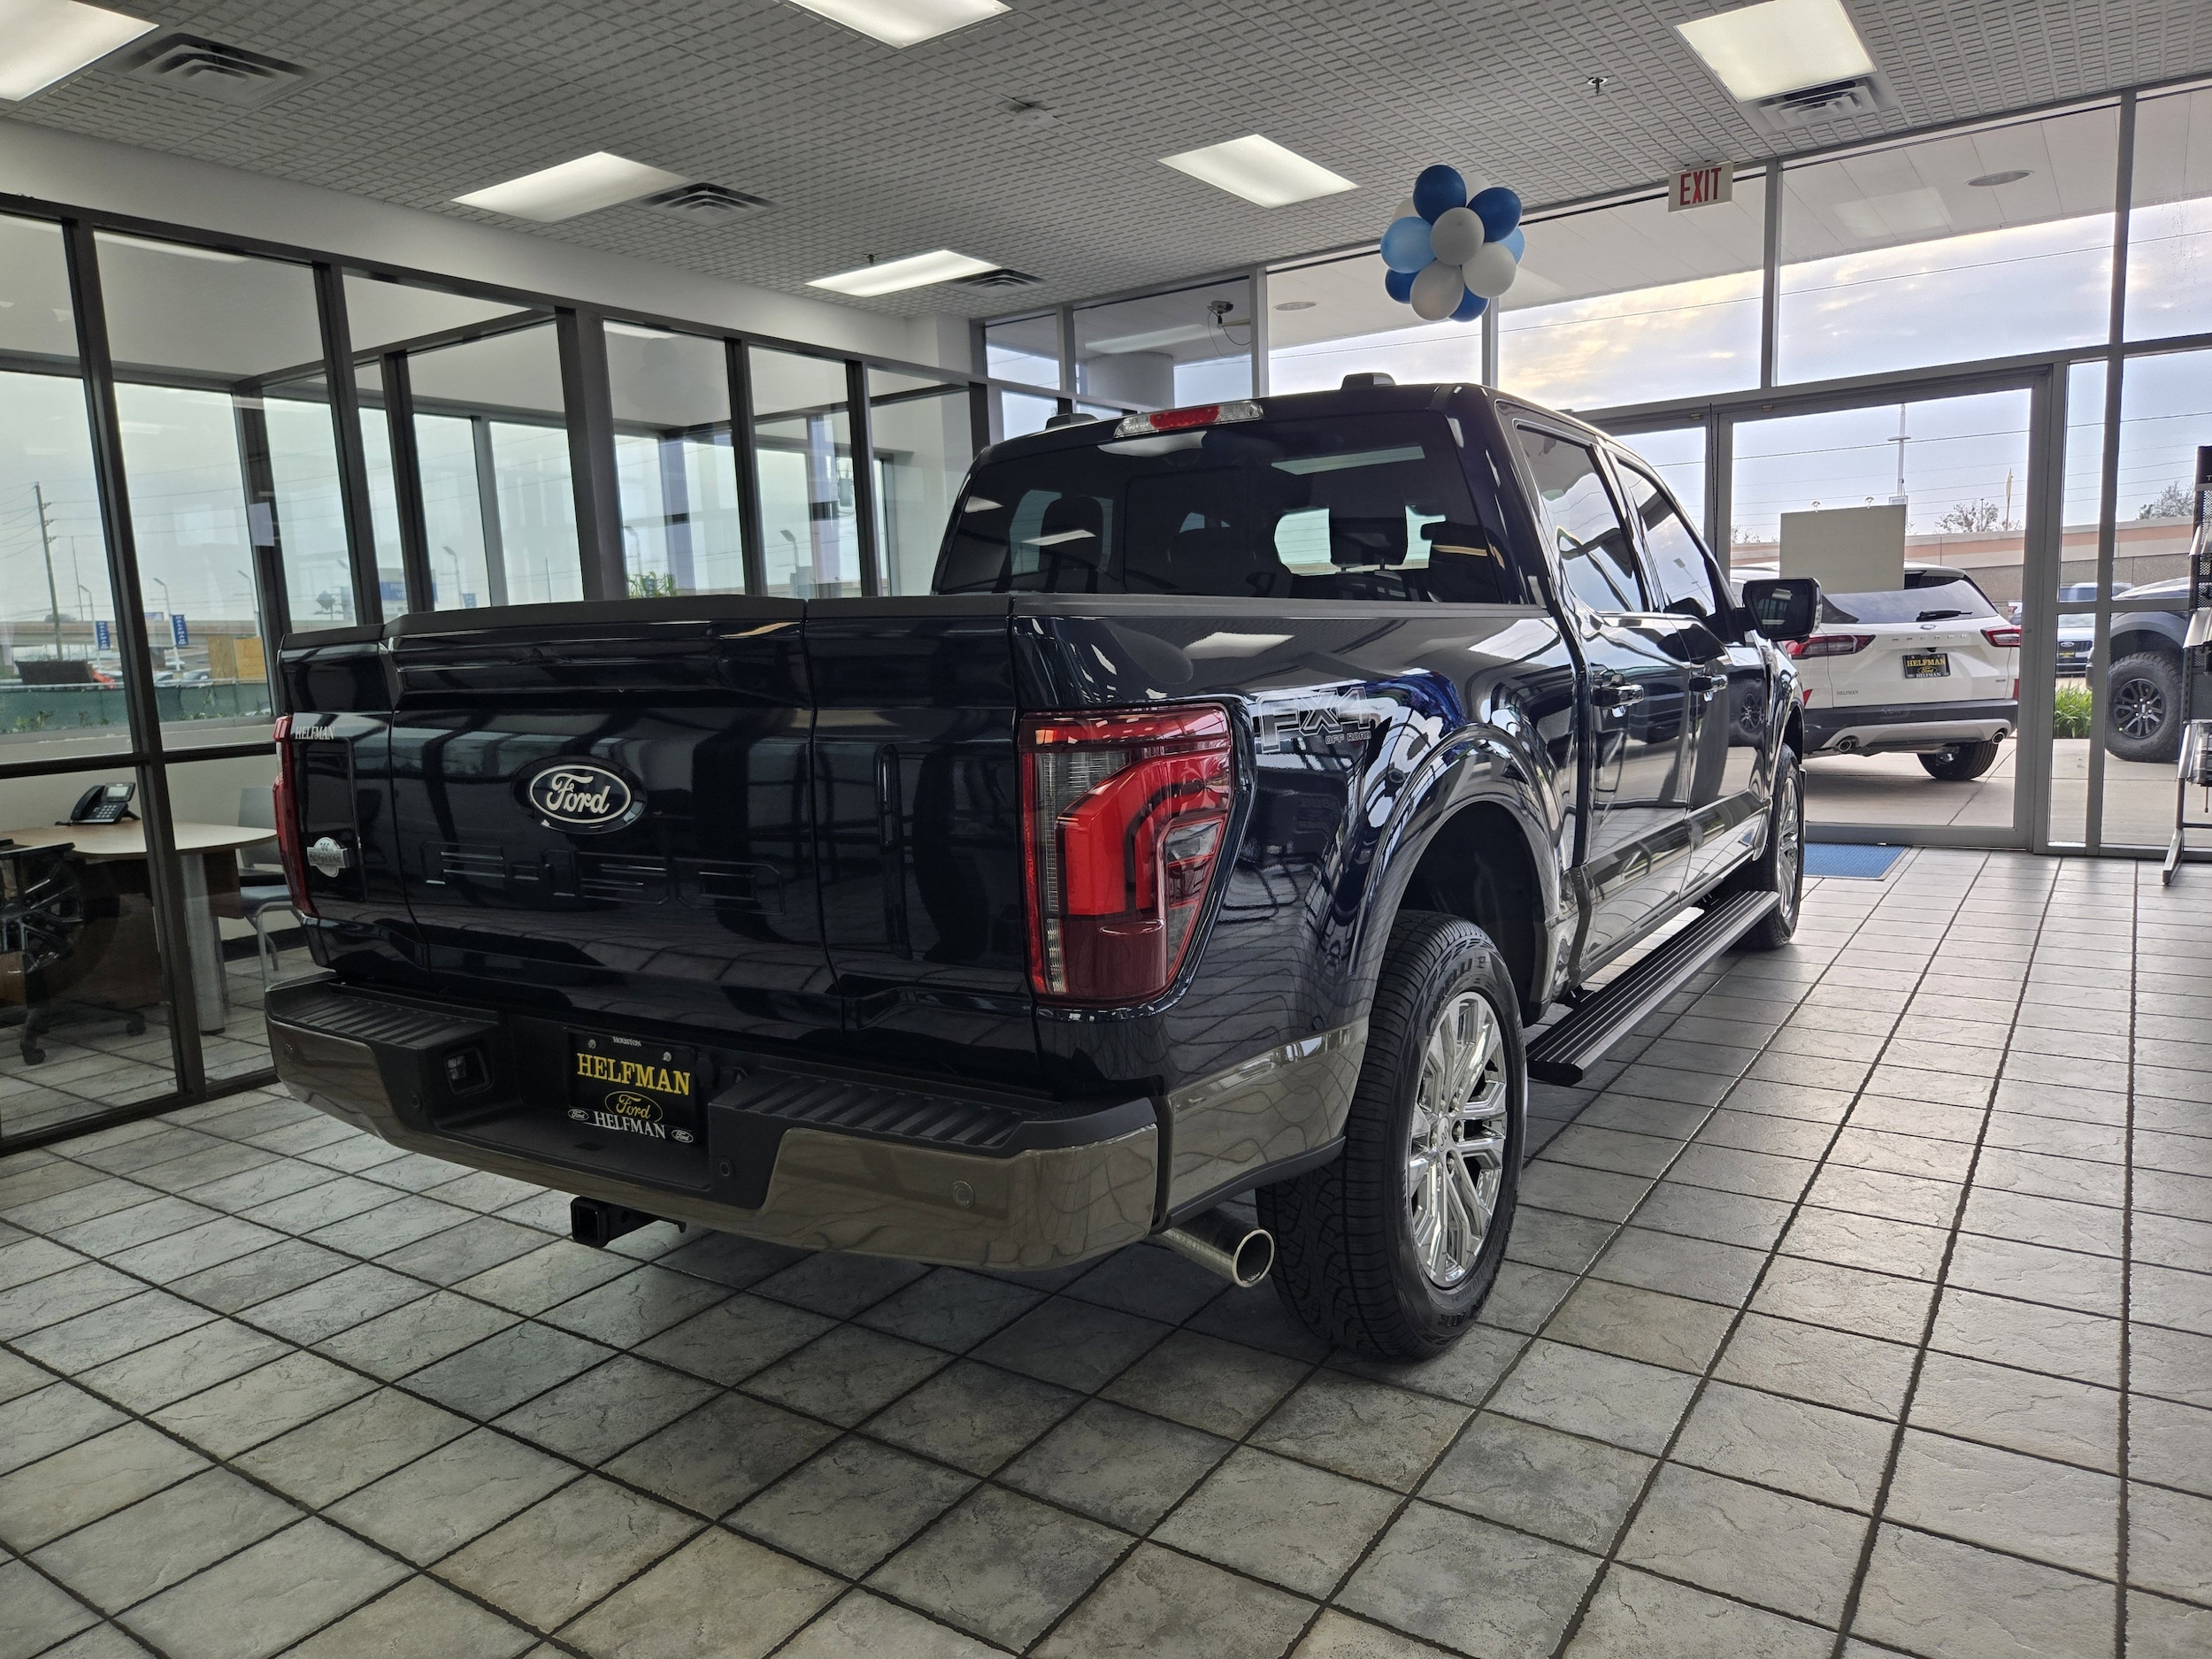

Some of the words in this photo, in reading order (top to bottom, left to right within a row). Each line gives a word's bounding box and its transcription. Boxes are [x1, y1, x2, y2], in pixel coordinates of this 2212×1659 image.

[1679, 166, 1722, 206] EXIT
[1906, 657, 1947, 668] HELFMAN
[295, 726, 335, 741] HELFMAN
[1255, 686, 1371, 754] FX4
[1325, 733, 1345, 745] OFF
[546, 772, 612, 815] Ford
[612, 1035, 642, 1048] HOUSTON
[577, 1052, 691, 1096] HELFMAN
[616, 1094, 652, 1119] Ford
[594, 1110, 666, 1140] HELFMAN
